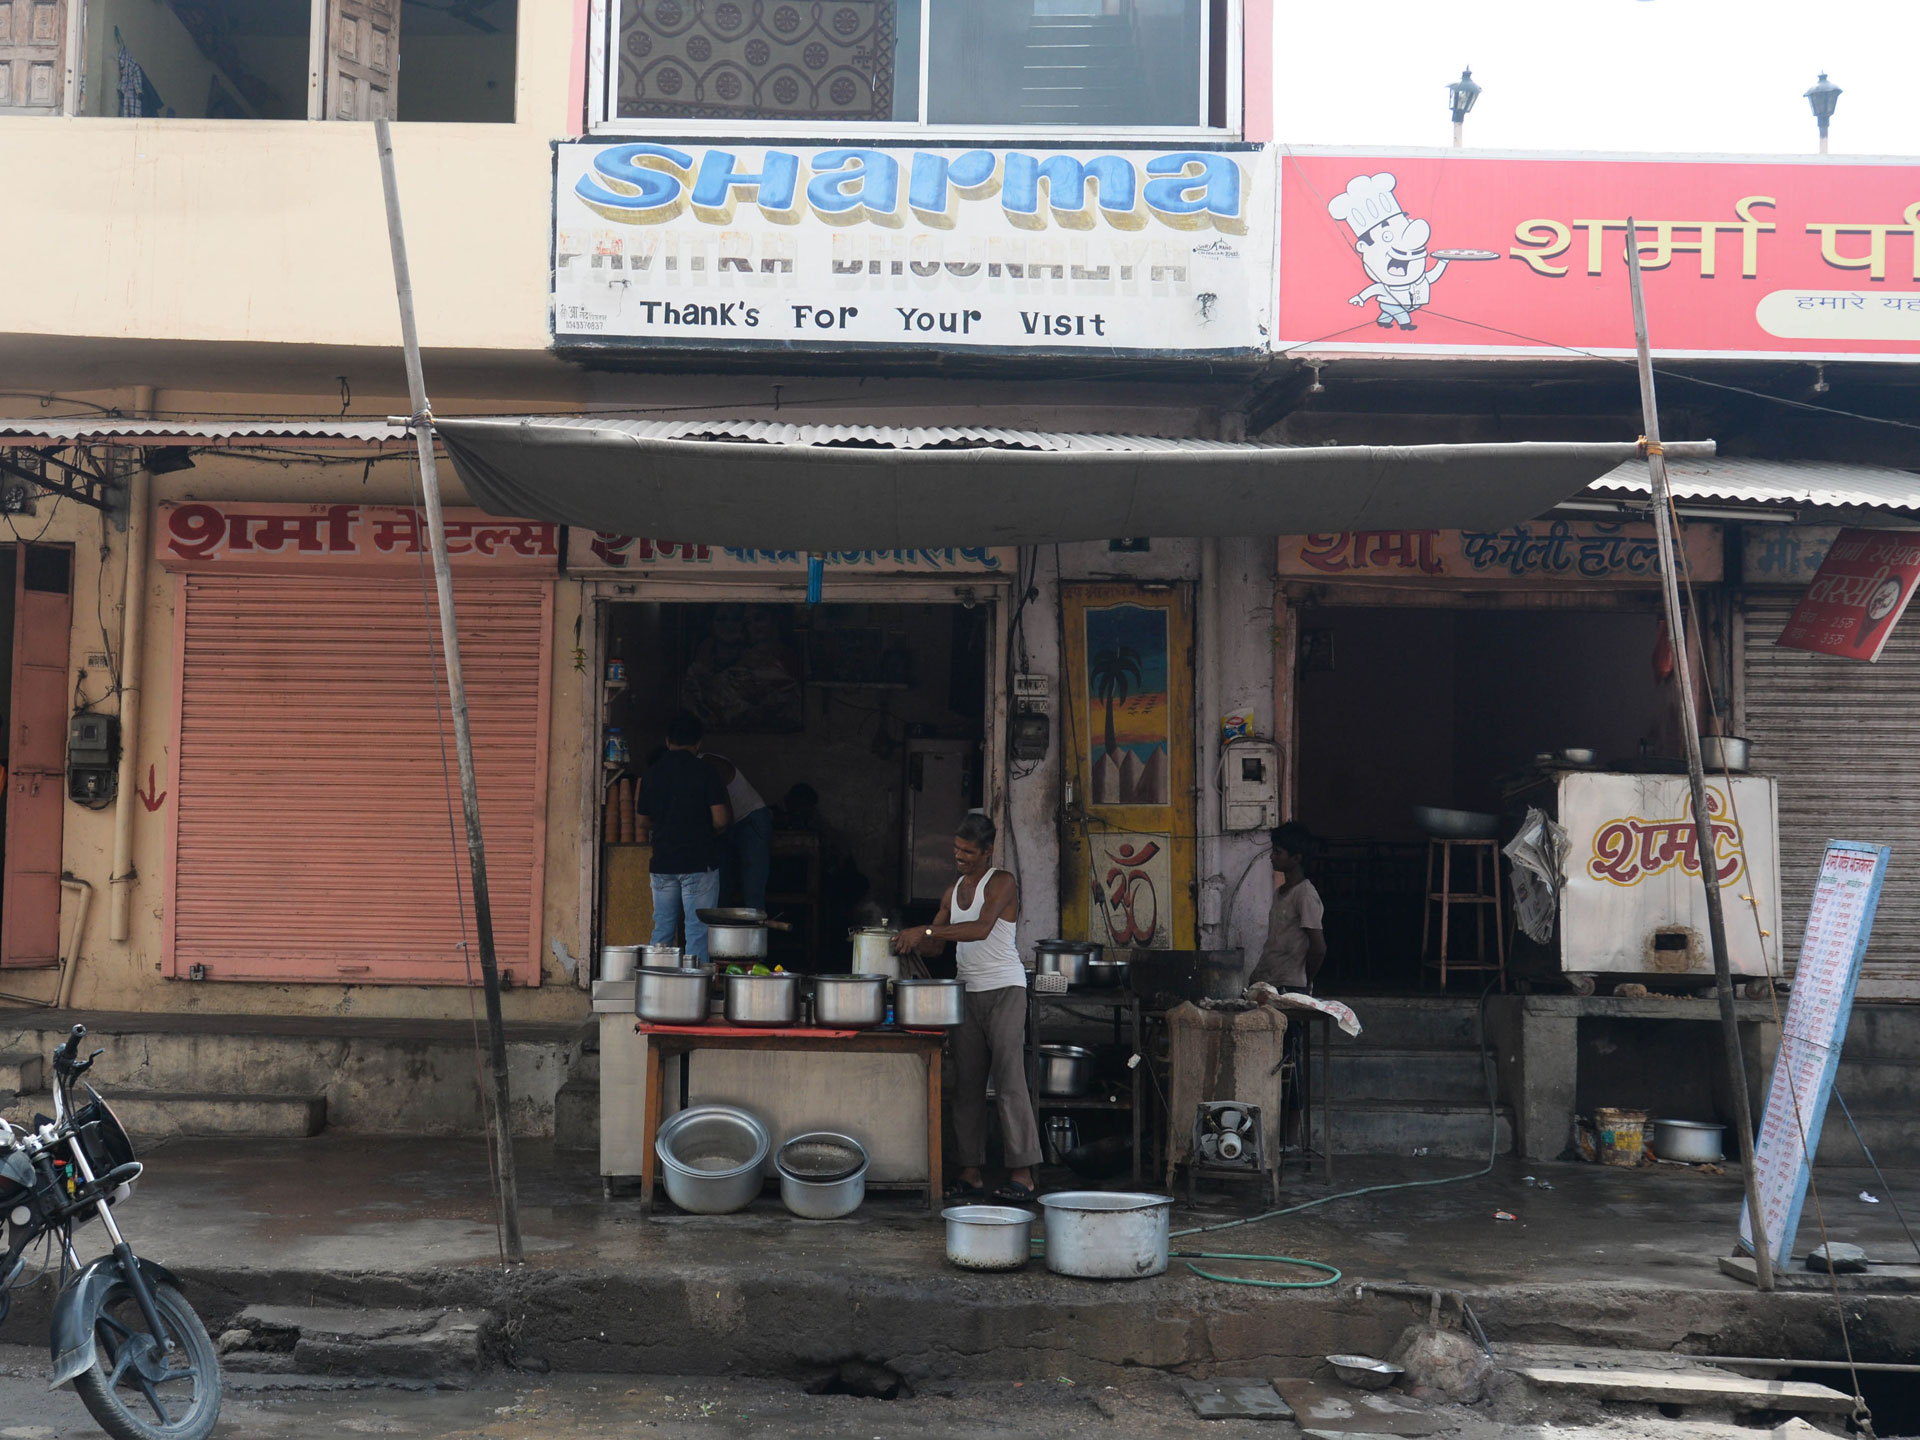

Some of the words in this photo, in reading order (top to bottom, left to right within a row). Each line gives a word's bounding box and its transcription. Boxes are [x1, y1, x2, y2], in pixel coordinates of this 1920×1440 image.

[1509, 195, 1776, 279] शर्मा
[791, 305, 858, 329] For
[896, 307, 982, 334] Your
[1794, 292, 1867, 310] हमारे
[168, 503, 364, 561] शर्मा
